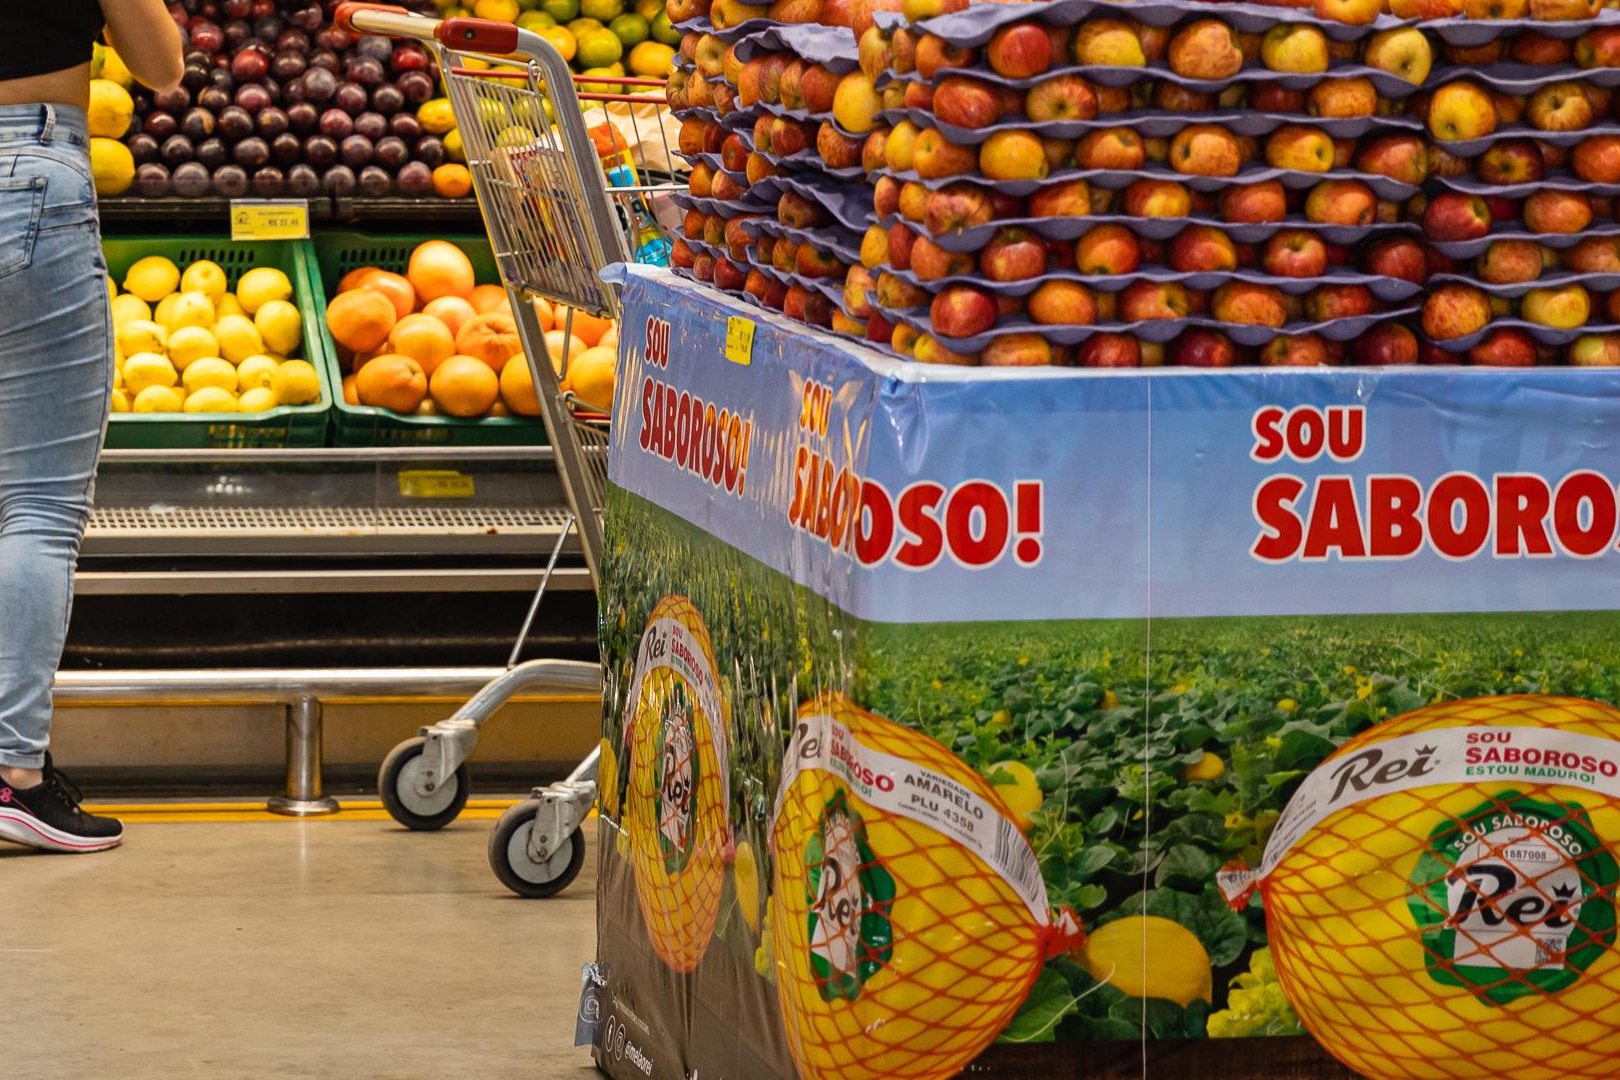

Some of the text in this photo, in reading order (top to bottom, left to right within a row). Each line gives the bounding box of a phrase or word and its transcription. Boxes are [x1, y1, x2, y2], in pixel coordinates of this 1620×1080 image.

[644, 314, 671, 369] SOU
[800, 377, 832, 439] SOU
[640, 375, 751, 500] SABOROSO!
[1250, 405, 1366, 463] SOU
[1249, 469, 1620, 564] SABORO
[645, 625, 667, 668] Rei
[1465, 731, 1512, 745] SOU
[1327, 744, 1438, 804] Rei
[1465, 746, 1619, 778] SABOROSO
[1465, 765, 1597, 785] ESTOU MADURO!
[903, 774, 984, 820] AMARELO
[911, 794, 938, 812] PLU
[943, 807, 974, 832] 4358
[1454, 822, 1487, 852] SOU
